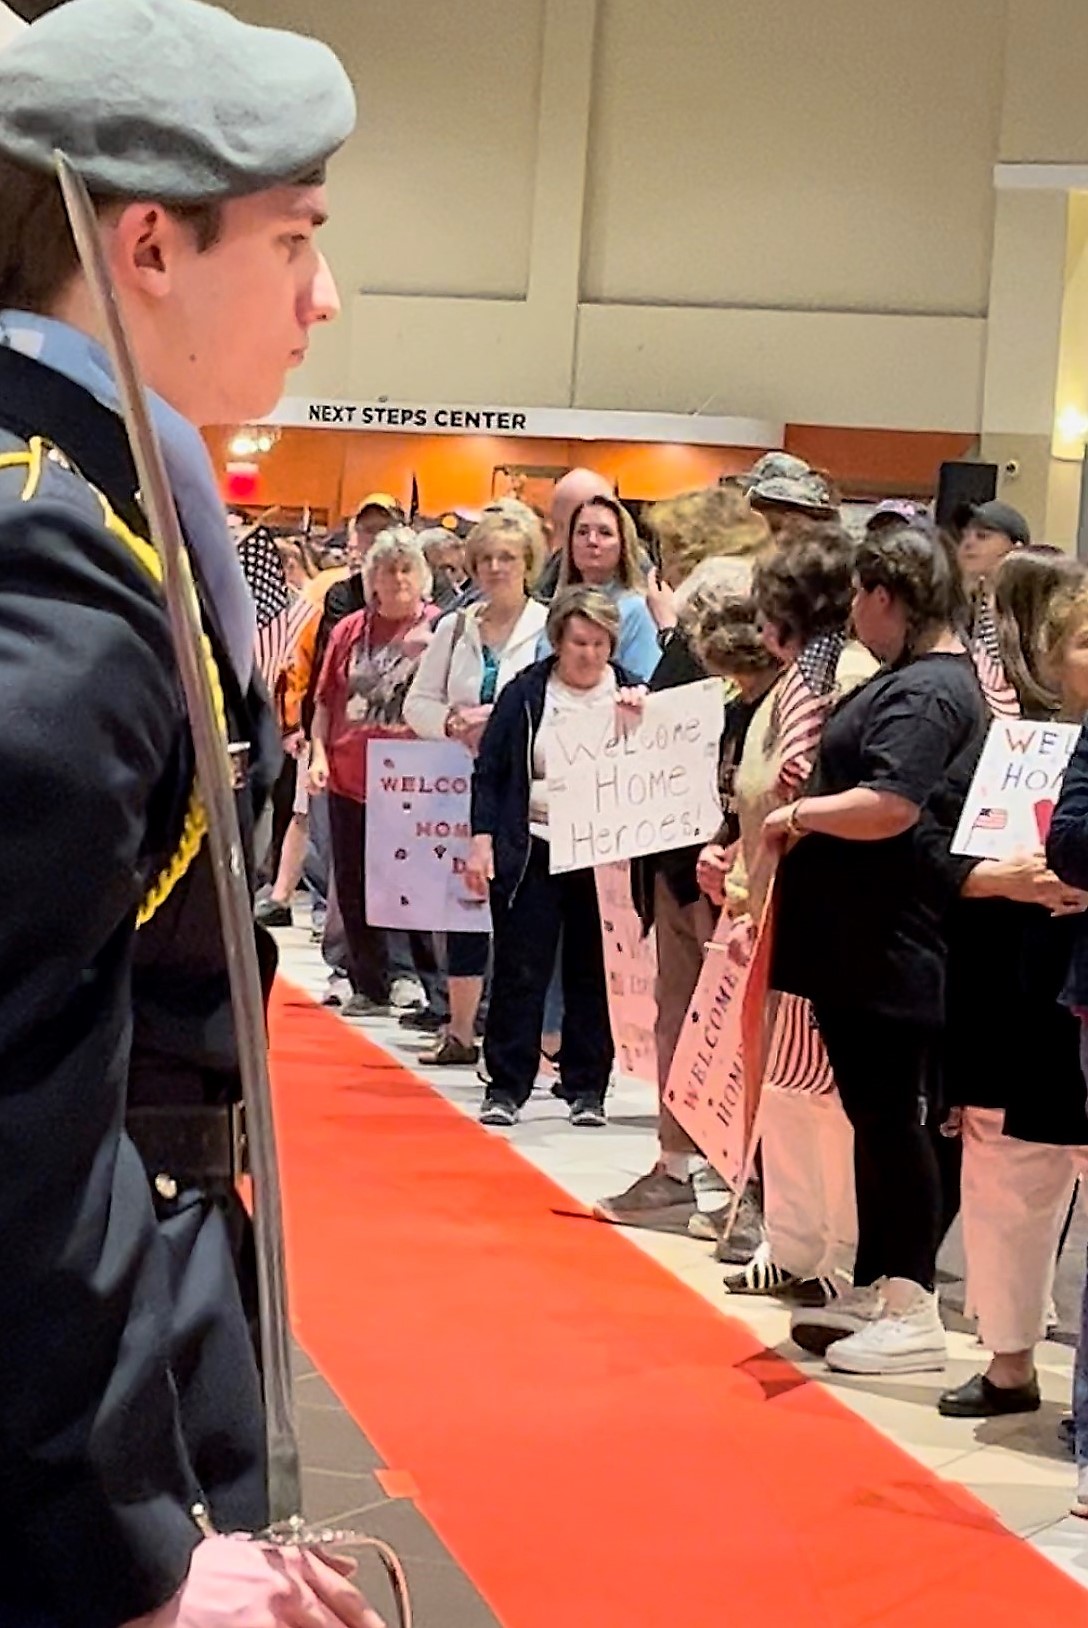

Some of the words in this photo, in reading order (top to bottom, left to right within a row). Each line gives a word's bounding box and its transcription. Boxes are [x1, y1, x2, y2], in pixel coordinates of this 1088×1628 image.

[309, 405, 356, 422] NEXT
[362, 407, 427, 426] STEPS
[434, 410, 527, 430] CENTER
[1006, 728, 1074, 755] WEL
[381, 776, 468, 794] WELCO
[415, 821, 468, 837] HOM
[452, 857, 467, 874] D
[683, 968, 738, 1110] WELCOME
[717, 1043, 743, 1127] HOM
